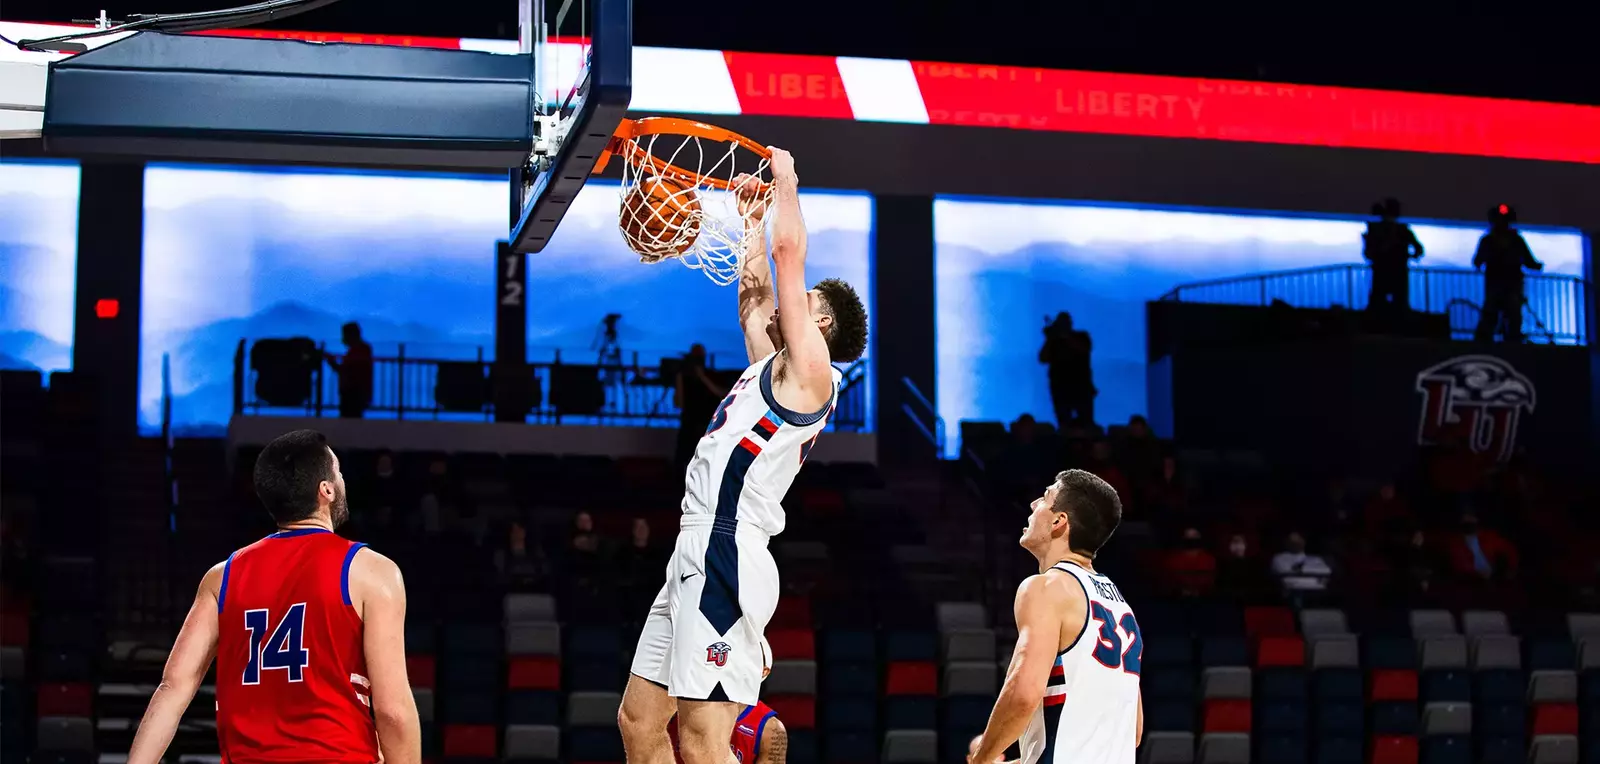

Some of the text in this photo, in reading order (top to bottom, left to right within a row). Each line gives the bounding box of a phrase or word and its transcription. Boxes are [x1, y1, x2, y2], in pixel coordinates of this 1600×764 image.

[1055, 88, 1204, 120] LIBERTY
[242, 602, 309, 685] 14
[1090, 600, 1144, 677] 32
